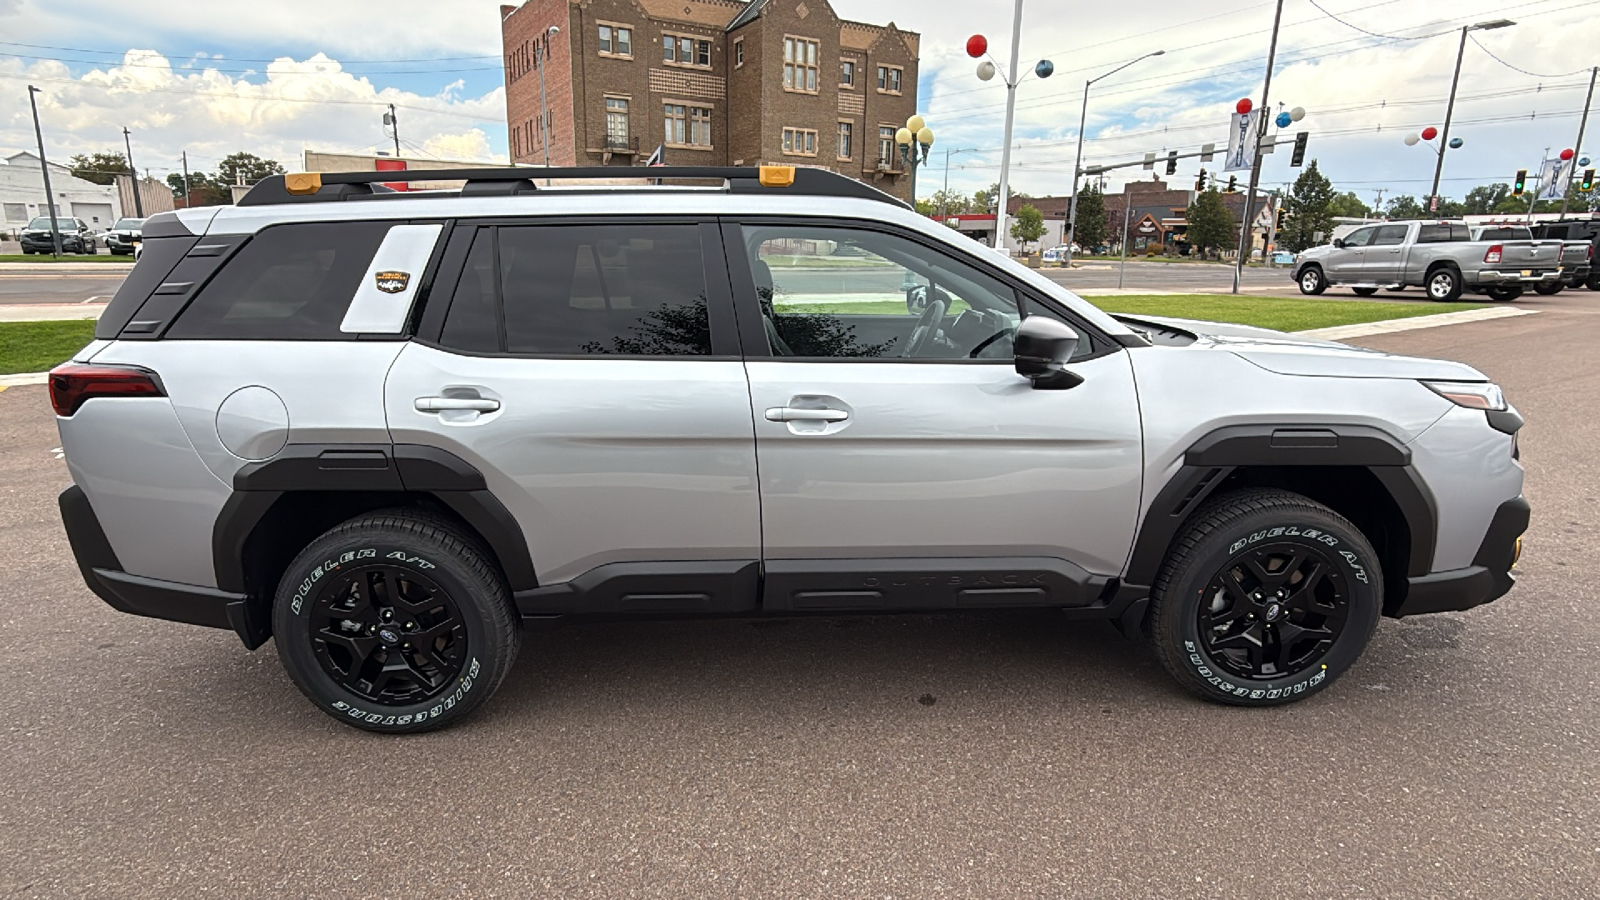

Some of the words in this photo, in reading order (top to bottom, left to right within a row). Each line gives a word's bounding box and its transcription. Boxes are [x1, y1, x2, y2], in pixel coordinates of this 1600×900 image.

[291, 548, 377, 615] DUELER
[386, 551, 436, 571] A/T
[863, 573, 1046, 587] OUTBACK
[1229, 526, 1339, 554] DUELER
[1339, 549, 1369, 584] A/T
[332, 656, 481, 725] BRIDGESTONE
[1184, 639, 1327, 699] BRIDGESTONE
